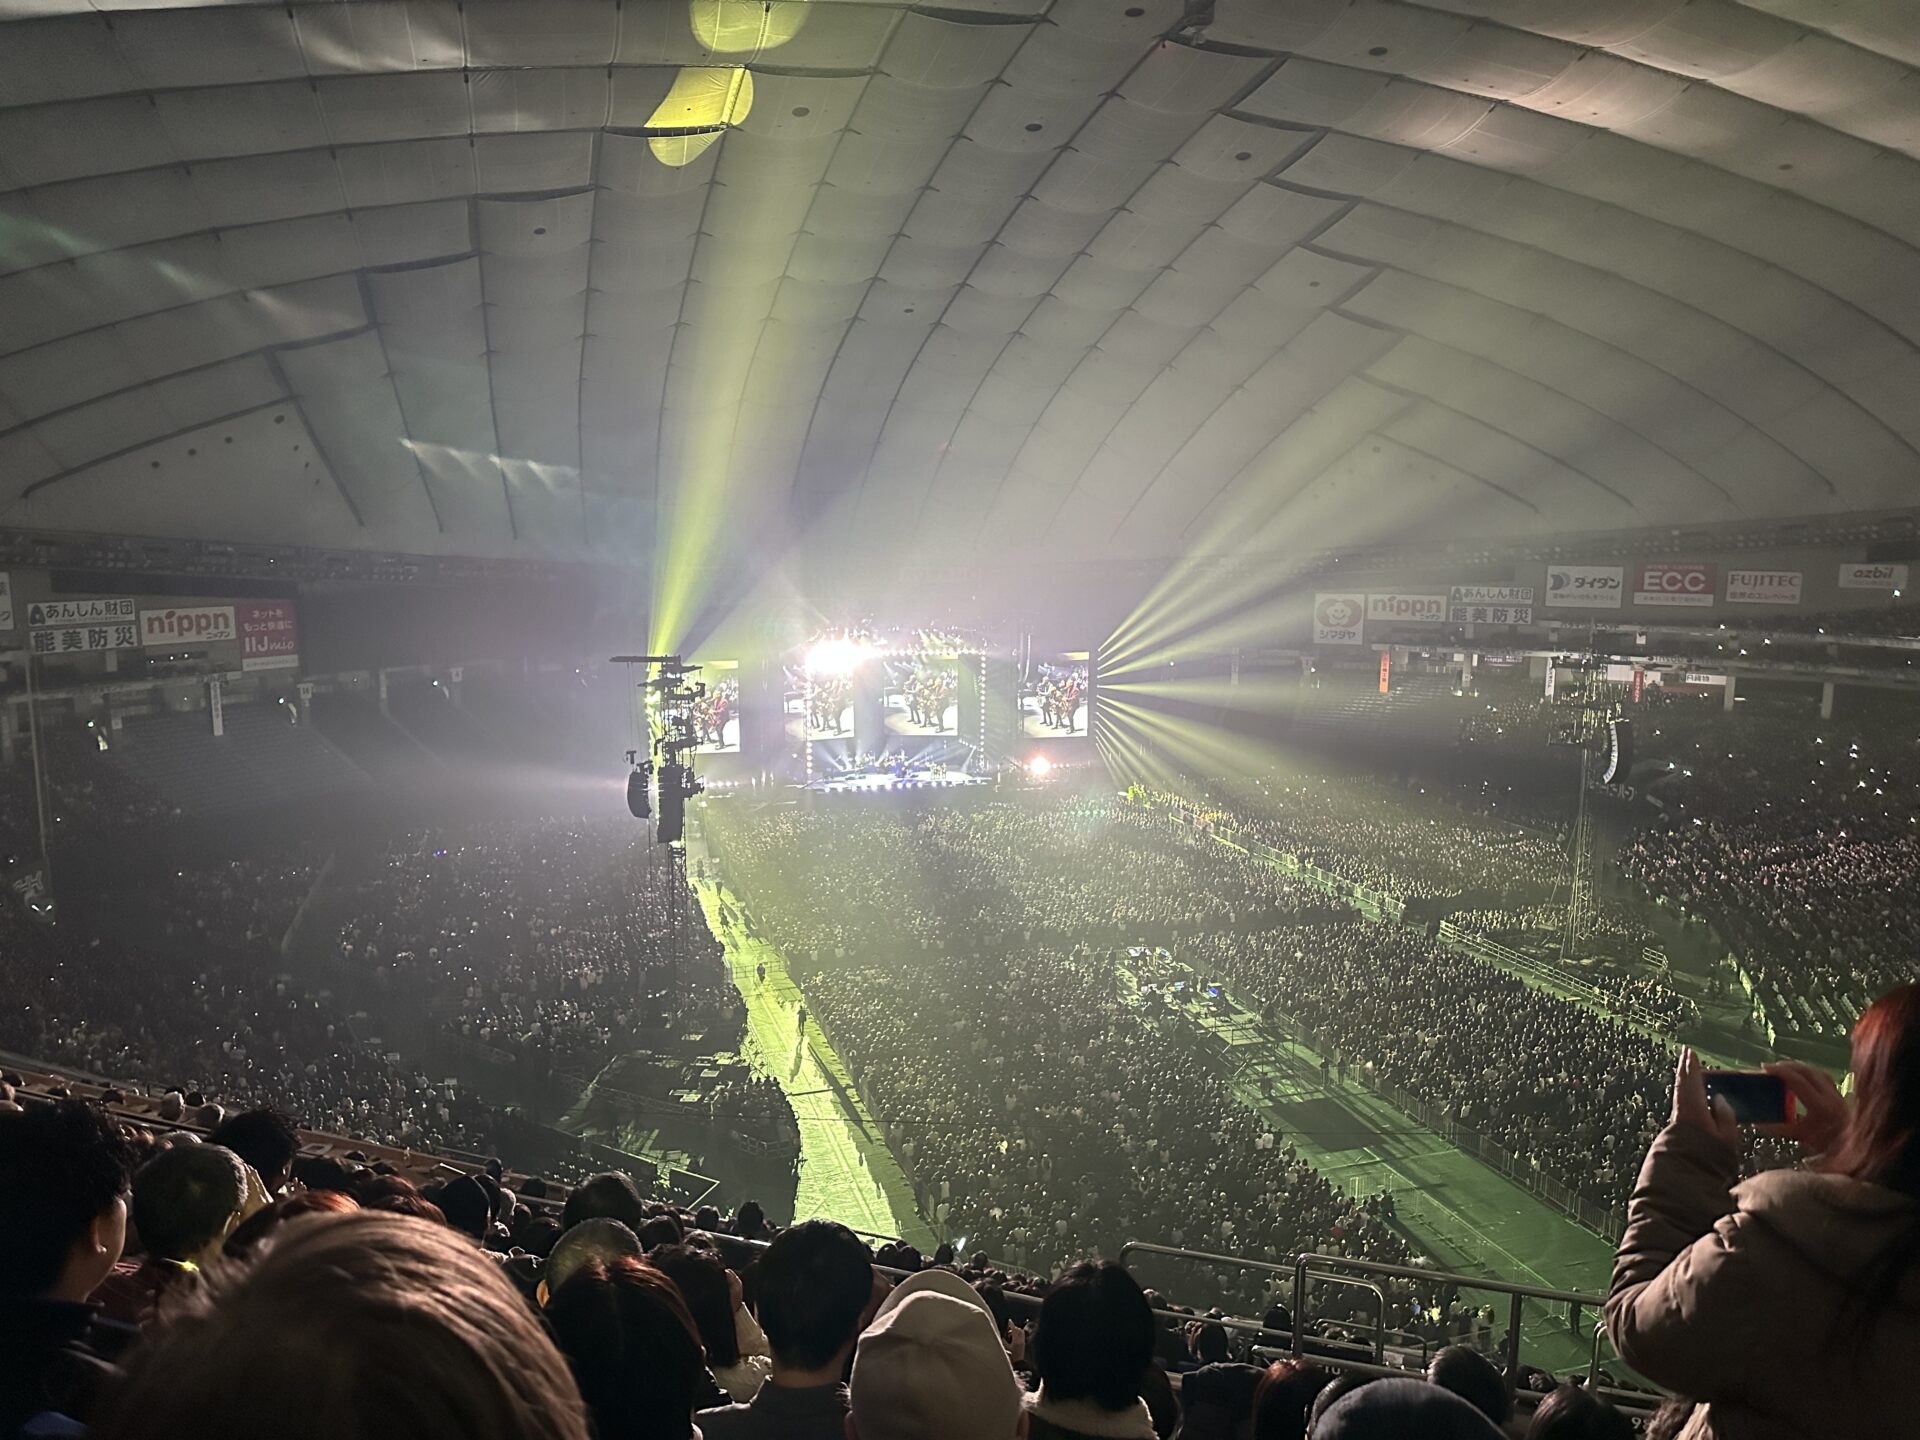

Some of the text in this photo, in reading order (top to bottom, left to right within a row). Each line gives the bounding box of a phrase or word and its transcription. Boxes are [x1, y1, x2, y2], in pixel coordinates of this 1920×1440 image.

[1853, 566, 1894, 579] azbil
[1574, 577, 1621, 590] ダイダン
[1643, 571, 1706, 592] ECC
[1730, 574, 1799, 588] FUJITEC
[1463, 587, 1532, 601] あんしん財団
[46, 600, 133, 618] あんしん財団
[1372, 595, 1441, 616] nippn
[146, 610, 230, 637] nippn
[1451, 608, 1529, 624] 能美防災
[33, 627, 134, 652] 能美防災
[1319, 629, 1357, 641] シマダヤ
